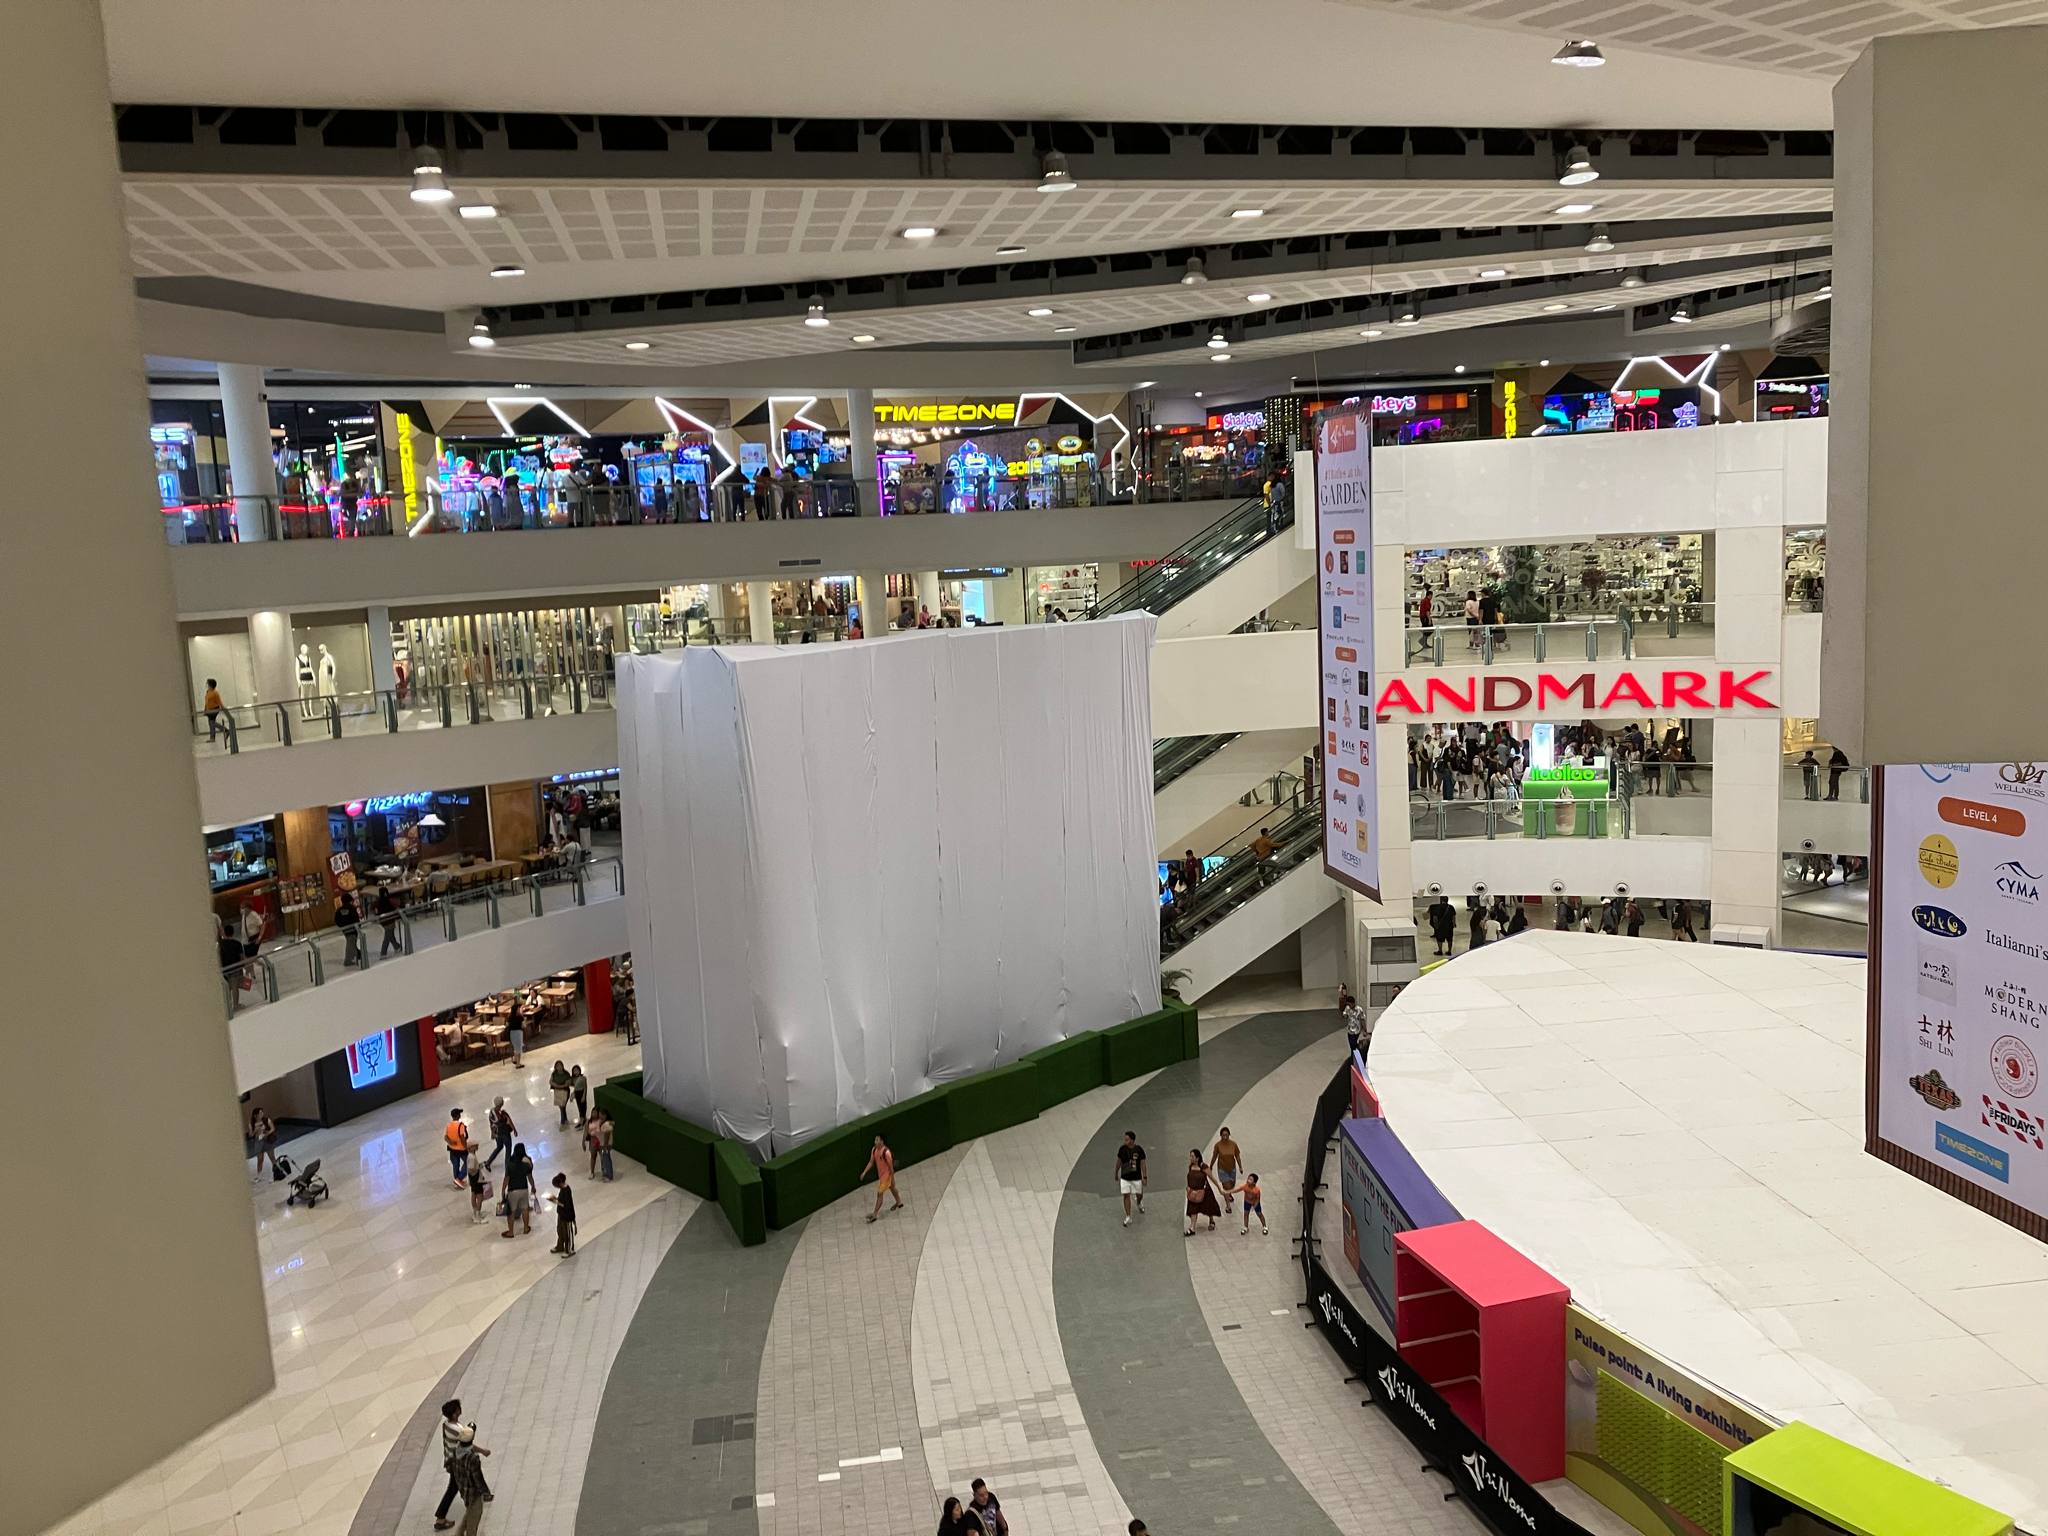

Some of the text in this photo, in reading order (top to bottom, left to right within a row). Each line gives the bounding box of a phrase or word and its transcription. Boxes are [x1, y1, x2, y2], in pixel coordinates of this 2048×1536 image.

[874, 403, 1015, 422] TIMEZONE
[396, 413, 418, 522] TIMEZONE
[1321, 481, 1367, 506] GARDEN
[1501, 588, 1686, 615] ANDMARK
[1376, 671, 1780, 721] ANDMARK
[365, 795, 402, 816] Pizza
[402, 791, 433, 808] Hut
[1994, 782, 2046, 798] WELLNESS
[1963, 807, 1998, 823] LEVEL 4
[1996, 877, 2039, 901] CYMA
[1986, 929, 2048, 961] Italianni's
[1984, 985, 2048, 1016] MODERN
[1918, 1014, 1955, 1044] 士林
[1991, 1003, 2040, 1029] SHANG
[1919, 1078, 1954, 1105] TEXAS
[1994, 1110, 2036, 1137] FRIDAYS
[1938, 1133, 2003, 1170] TIMEZONE
[1360, 1165, 1376, 1199] INTO
[1376, 1189, 1390, 1221] THE
[1392, 1367, 1436, 1430] TriNoma
[1574, 1327, 1754, 1444] Pulse point: A living exhibitio
[1479, 1454, 1537, 1531] TriNoma
